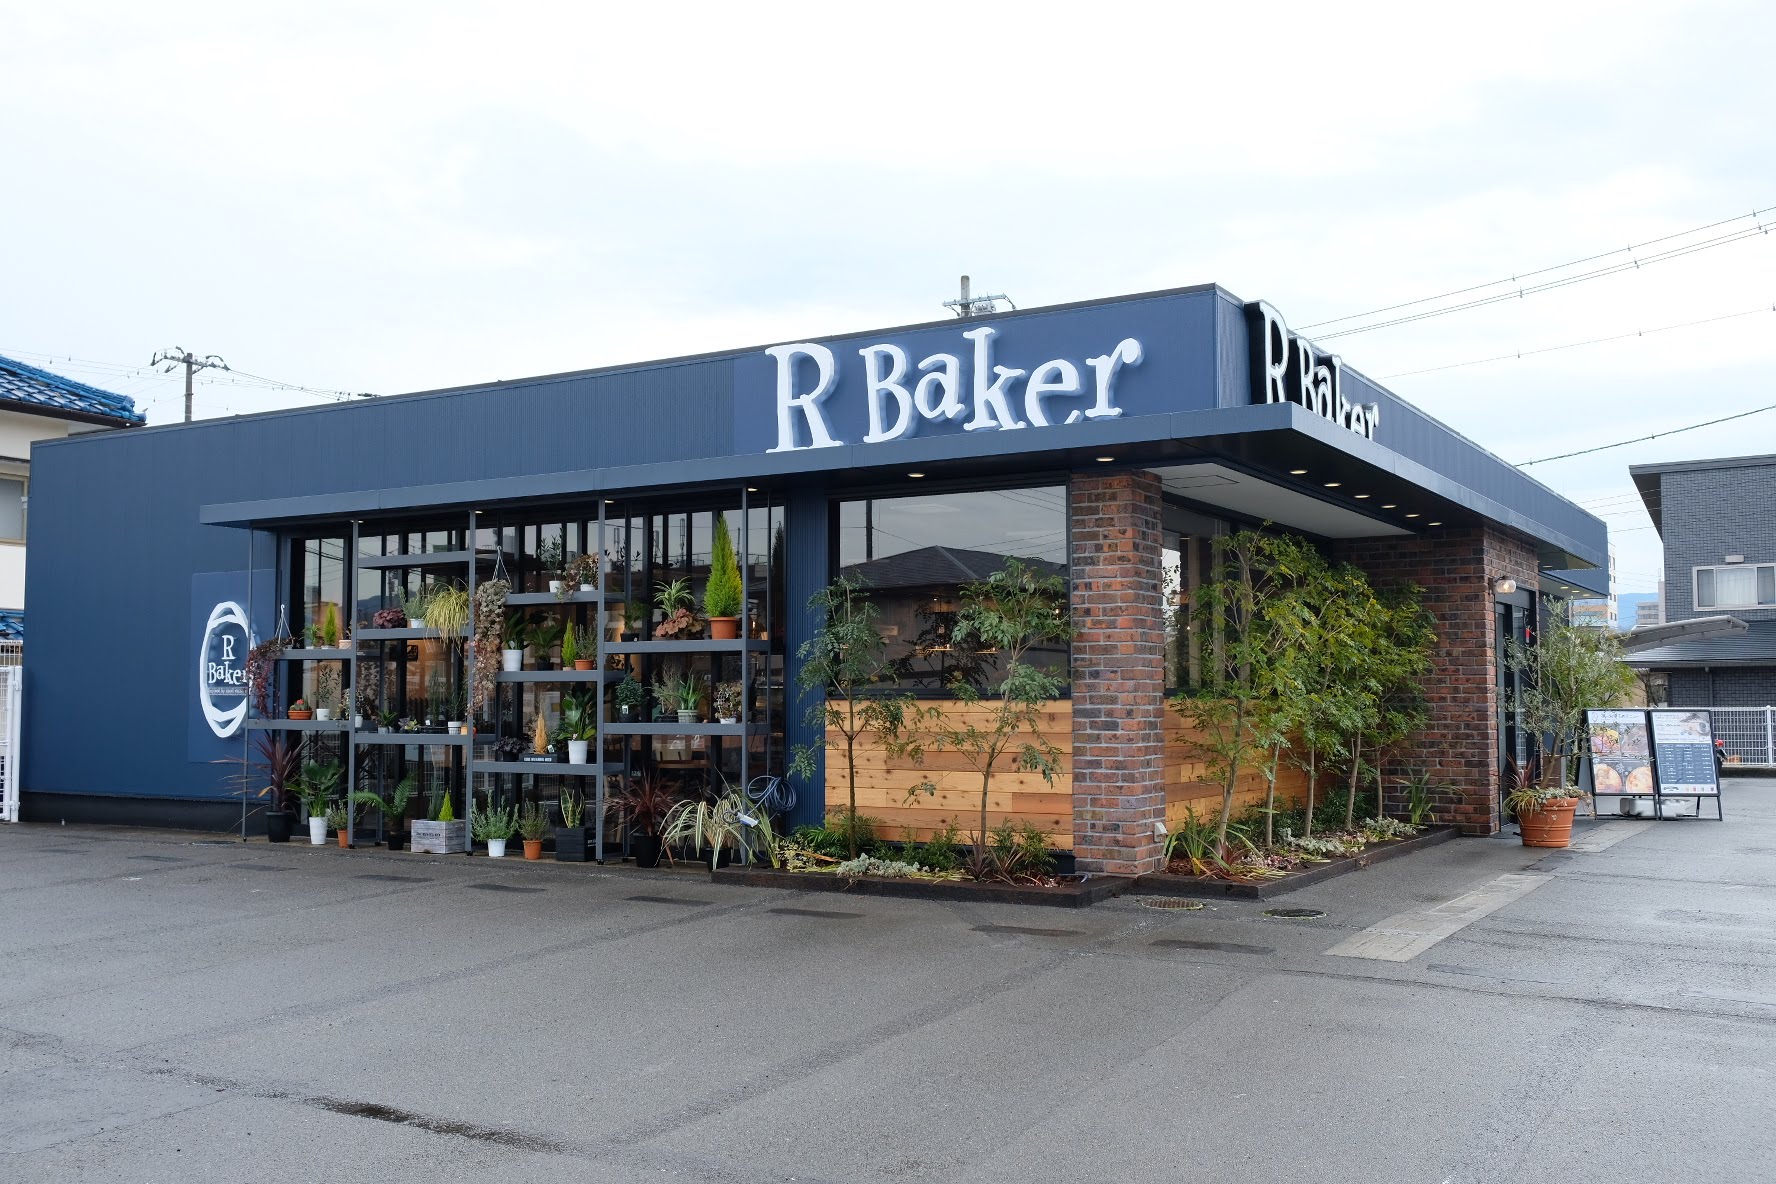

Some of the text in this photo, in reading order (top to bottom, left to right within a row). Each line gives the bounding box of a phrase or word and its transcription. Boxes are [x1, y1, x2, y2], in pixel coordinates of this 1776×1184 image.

[764, 326, 1143, 454] R Baker
[1259, 299, 1380, 441] R Baker
[221, 634, 237, 660] R
